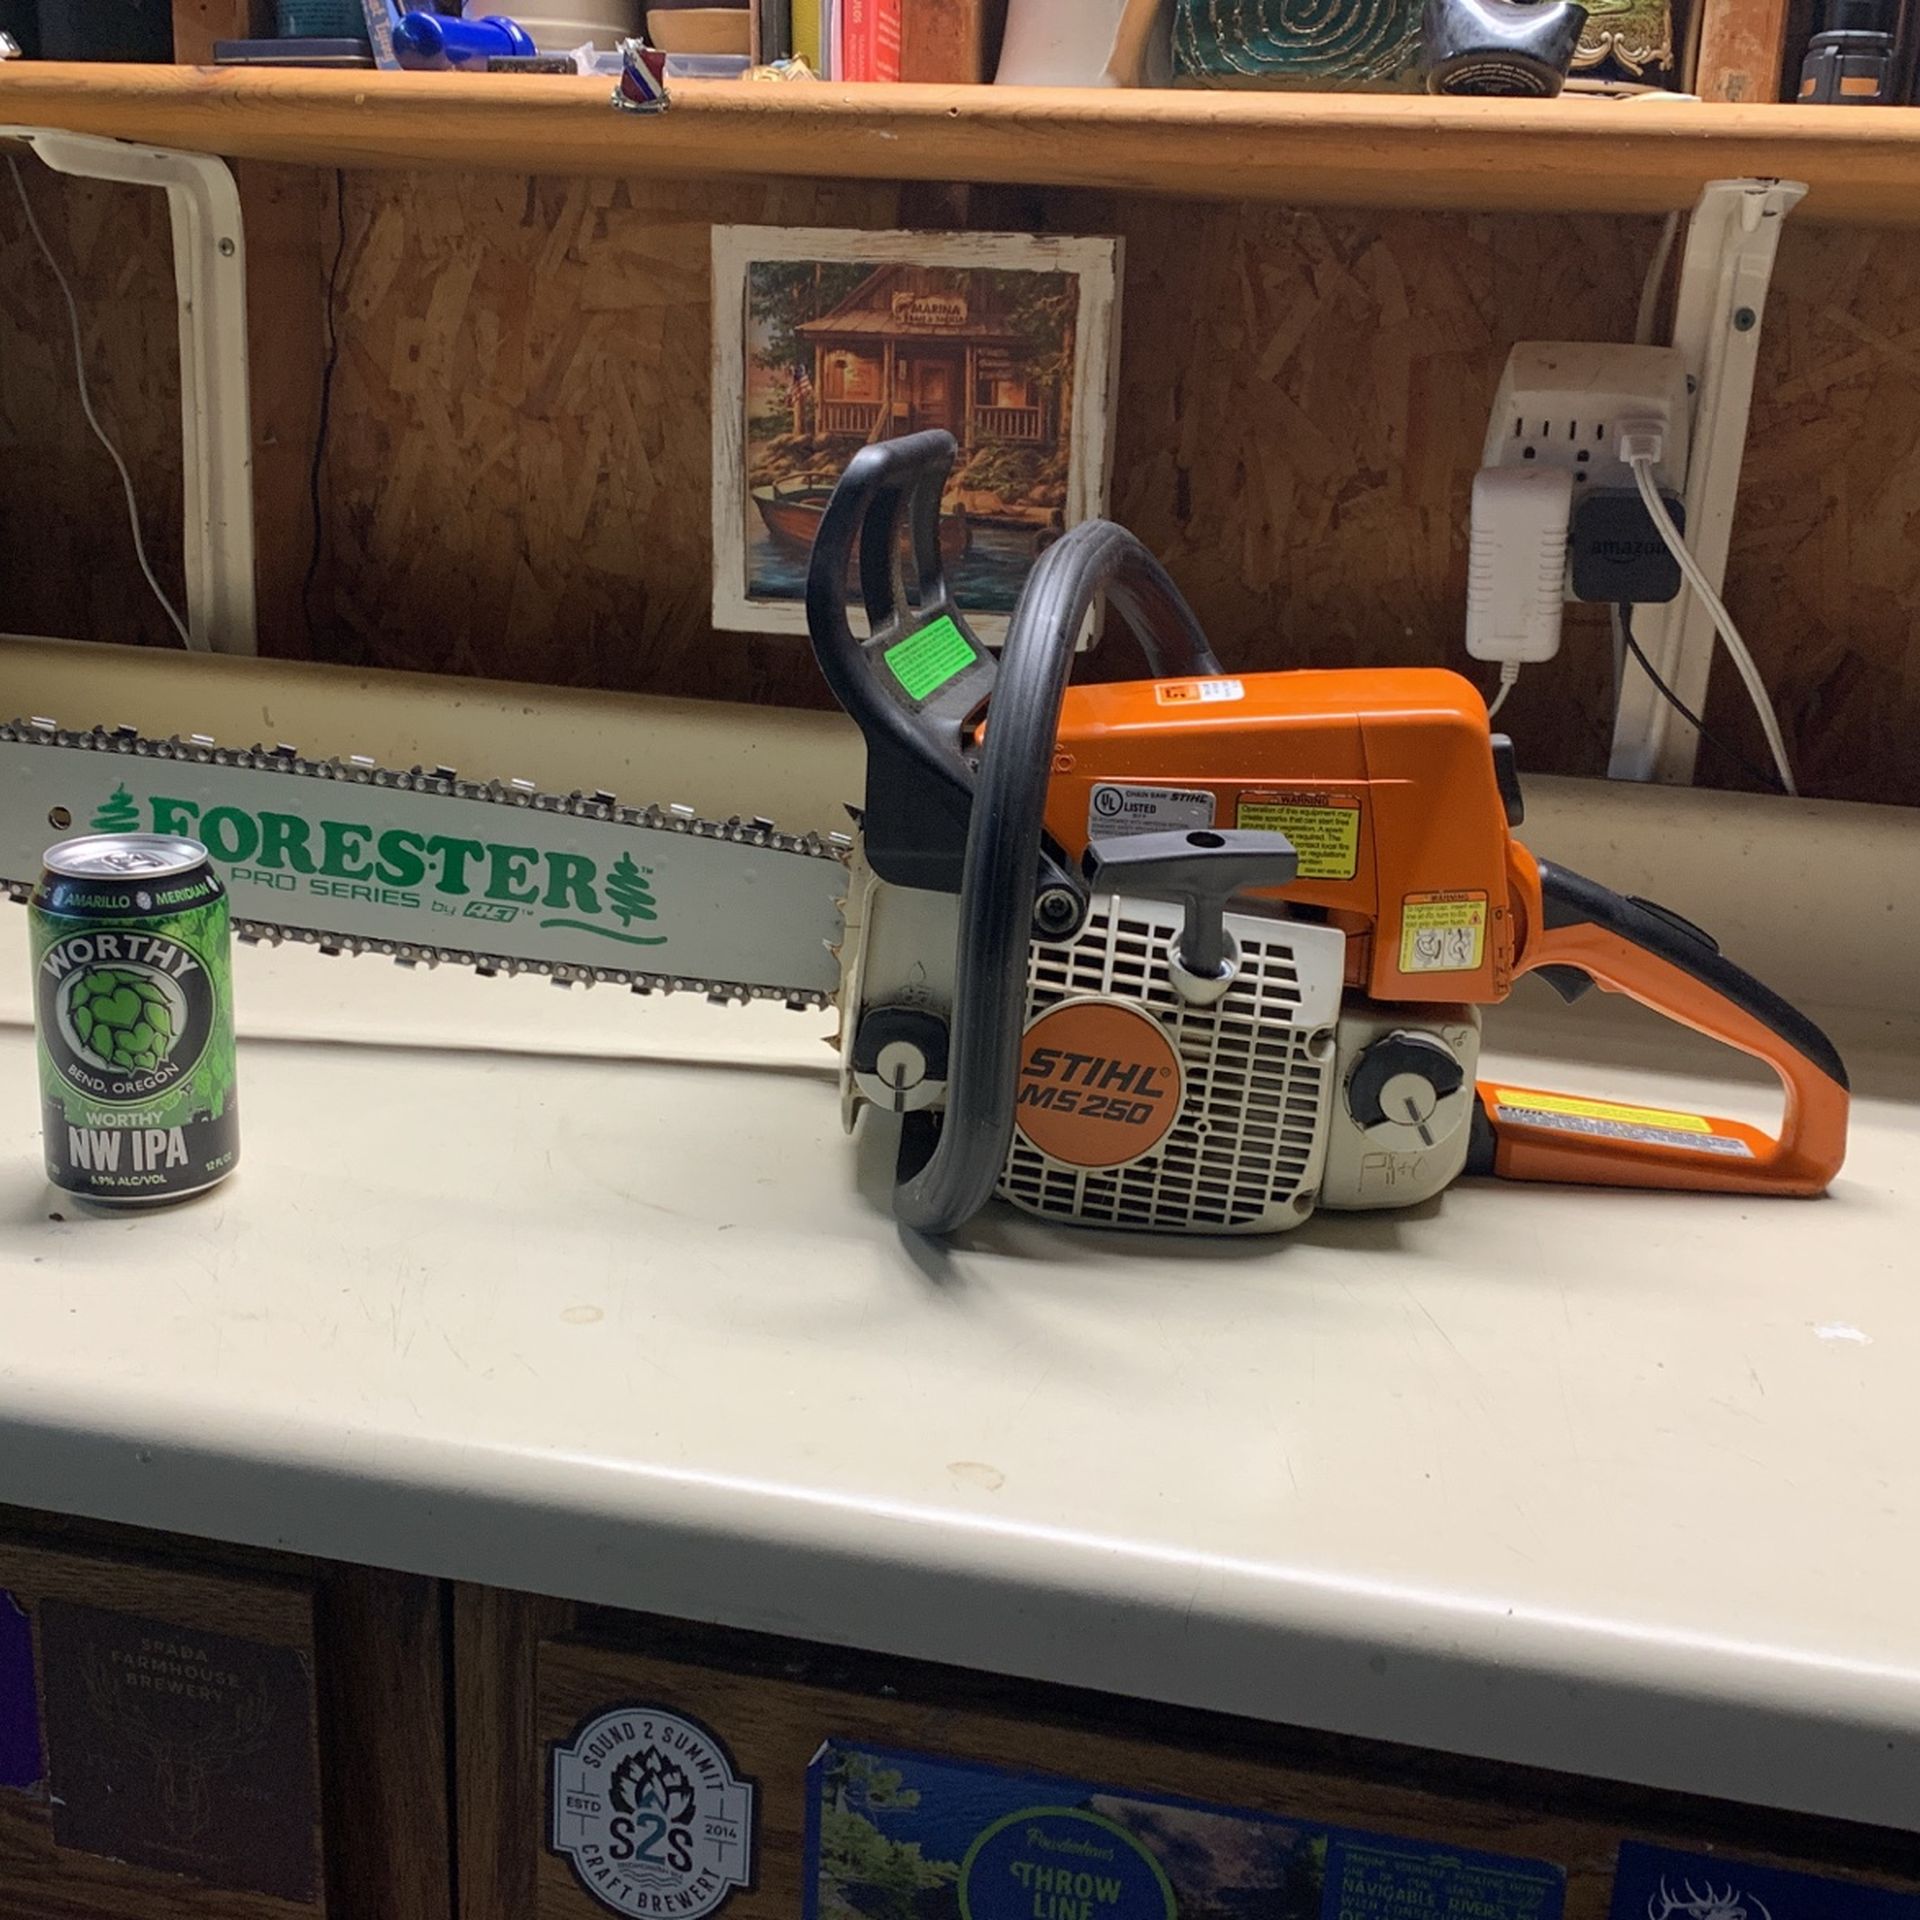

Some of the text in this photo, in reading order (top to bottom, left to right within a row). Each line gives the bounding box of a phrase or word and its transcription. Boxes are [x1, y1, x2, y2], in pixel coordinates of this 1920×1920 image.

[911, 303, 960, 315] MARINA
[1101, 793, 1116, 811] UL
[1124, 802, 1156, 814] LISTED
[1170, 793, 1209, 803] STIHL
[65, 891, 131, 909] AMARILLO
[155, 882, 211, 906] MERIDIAN
[230, 866, 296, 892] PRO
[310, 878, 421, 908] SERIES
[431, 900, 457, 917] by
[41, 934, 199, 980] WORTHY
[67, 1063, 180, 1094] BEND, OREGON
[86, 1110, 165, 1127] WORTHY
[1017, 1083, 1154, 1125] MS 250
[68, 1125, 189, 1172] NW IPA
[117, 1174, 168, 1186] ALC/VOL
[205, 1159, 215, 1172] 12
[141, 1637, 208, 1663] SPADA
[111, 1650, 241, 1689] FARMHOUSE
[126, 1673, 223, 1703] BREWERY
[583, 1721, 725, 1792] SOUND 2 SUMMIT
[566, 1796, 737, 1839] ESTD 2014
[609, 1813, 694, 1873] S2S
[582, 1843, 721, 1913] CRAFT BREWERY
[1009, 1860, 1122, 1905] THROW
[1343, 1878, 1435, 1907] NAVIGABLE
[1034, 1891, 1094, 1920] LINE
